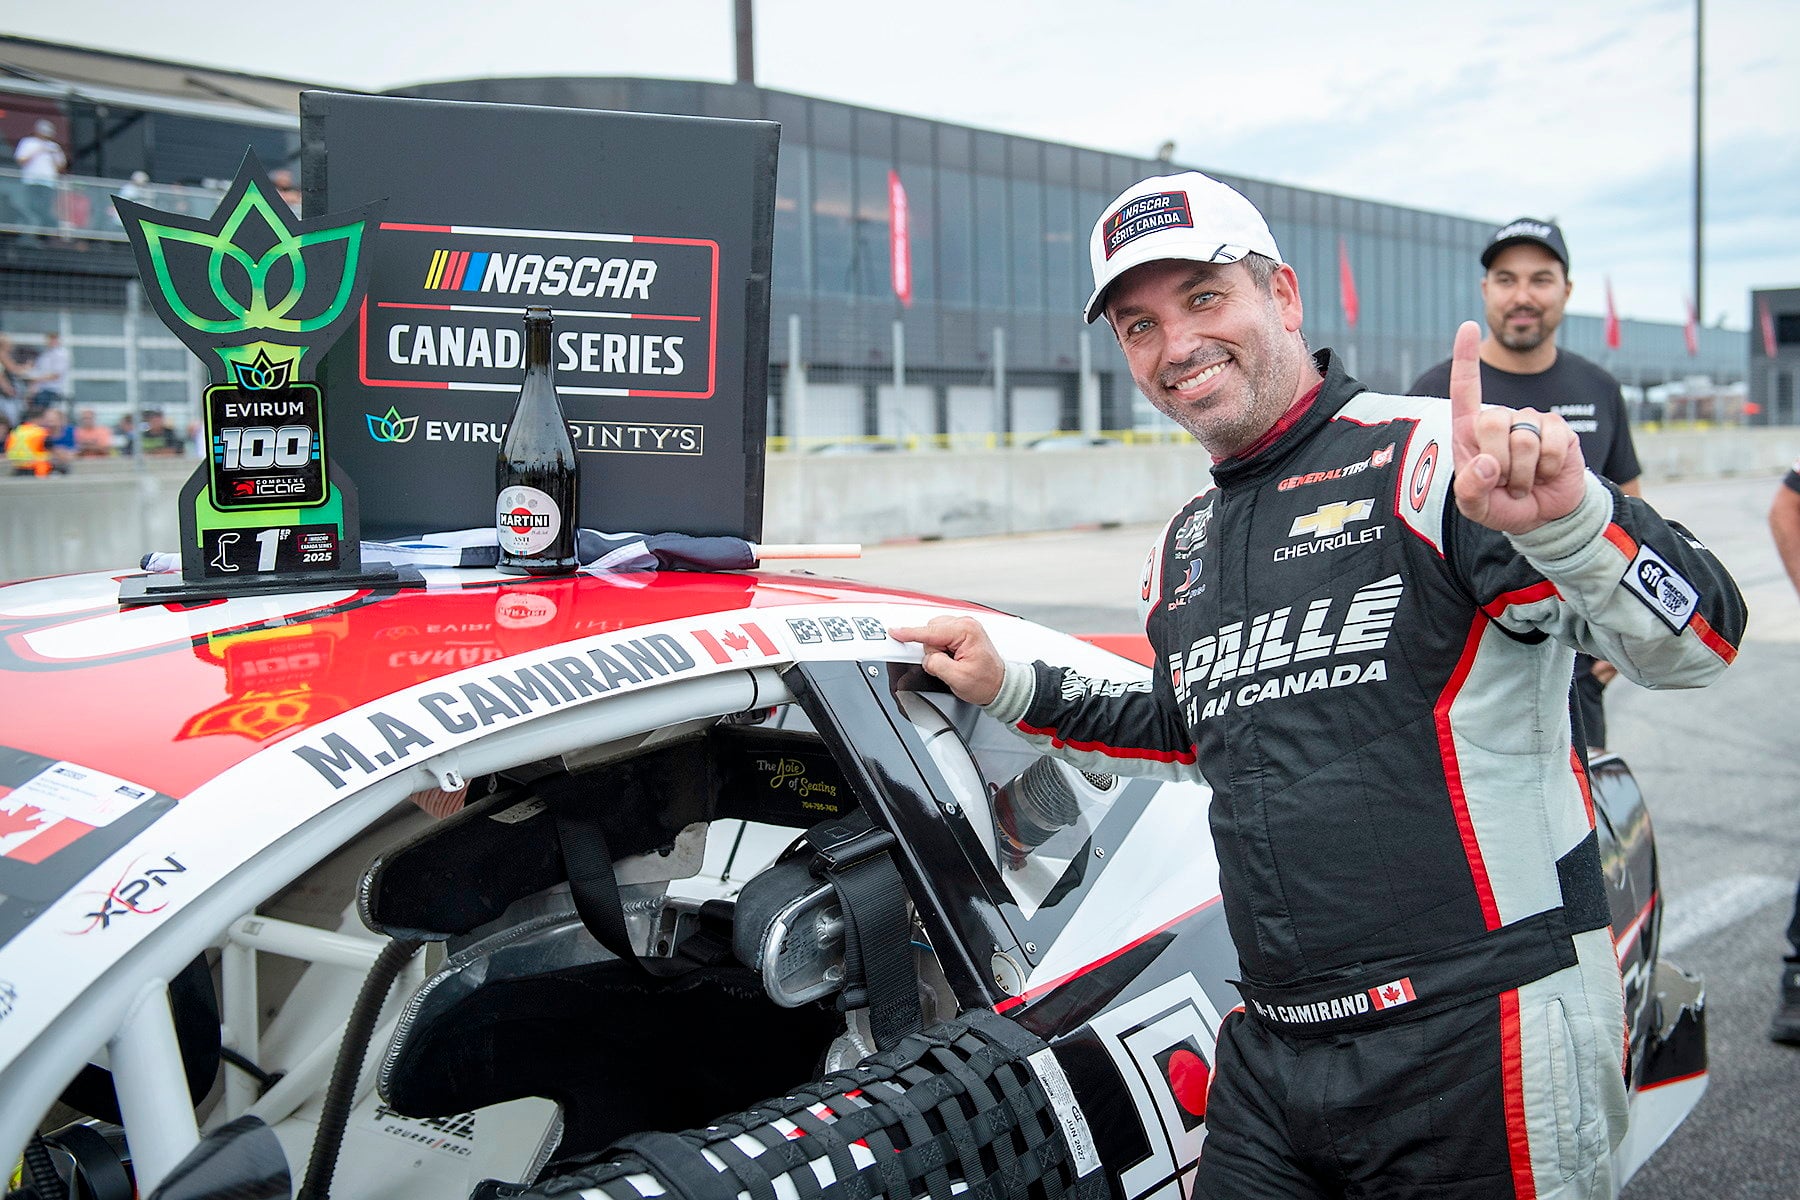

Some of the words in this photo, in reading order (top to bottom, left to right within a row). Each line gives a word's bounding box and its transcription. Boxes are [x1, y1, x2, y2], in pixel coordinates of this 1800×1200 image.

[1125, 197, 1170, 220] NASCAR
[1111, 226, 1136, 248] SÉRIE
[1136, 212, 1180, 233] CANADA
[480, 252, 657, 300] NASCAR
[388, 324, 526, 370] CANAD
[558, 332, 684, 376] SERIES
[225, 401, 304, 418] EVIRUM
[426, 420, 507, 443] EVIRU
[220, 424, 313, 472] 100
[255, 477, 304, 485] COMPLEXE
[501, 514, 548, 527] MARTINI
[302, 552, 333, 563] 2025
[1273, 525, 1386, 562] CHEVROLET
[1236, 659, 1388, 707] CANADA
[292, 711, 435, 790] M.A
[418, 633, 697, 735] CAMIRAND
[756, 759, 777, 772] The
[788, 777, 800, 791] of
[799, 777, 837, 797] Seating
[84, 855, 187, 929] XPN
[1277, 992, 1370, 1024] CAMIRAND
